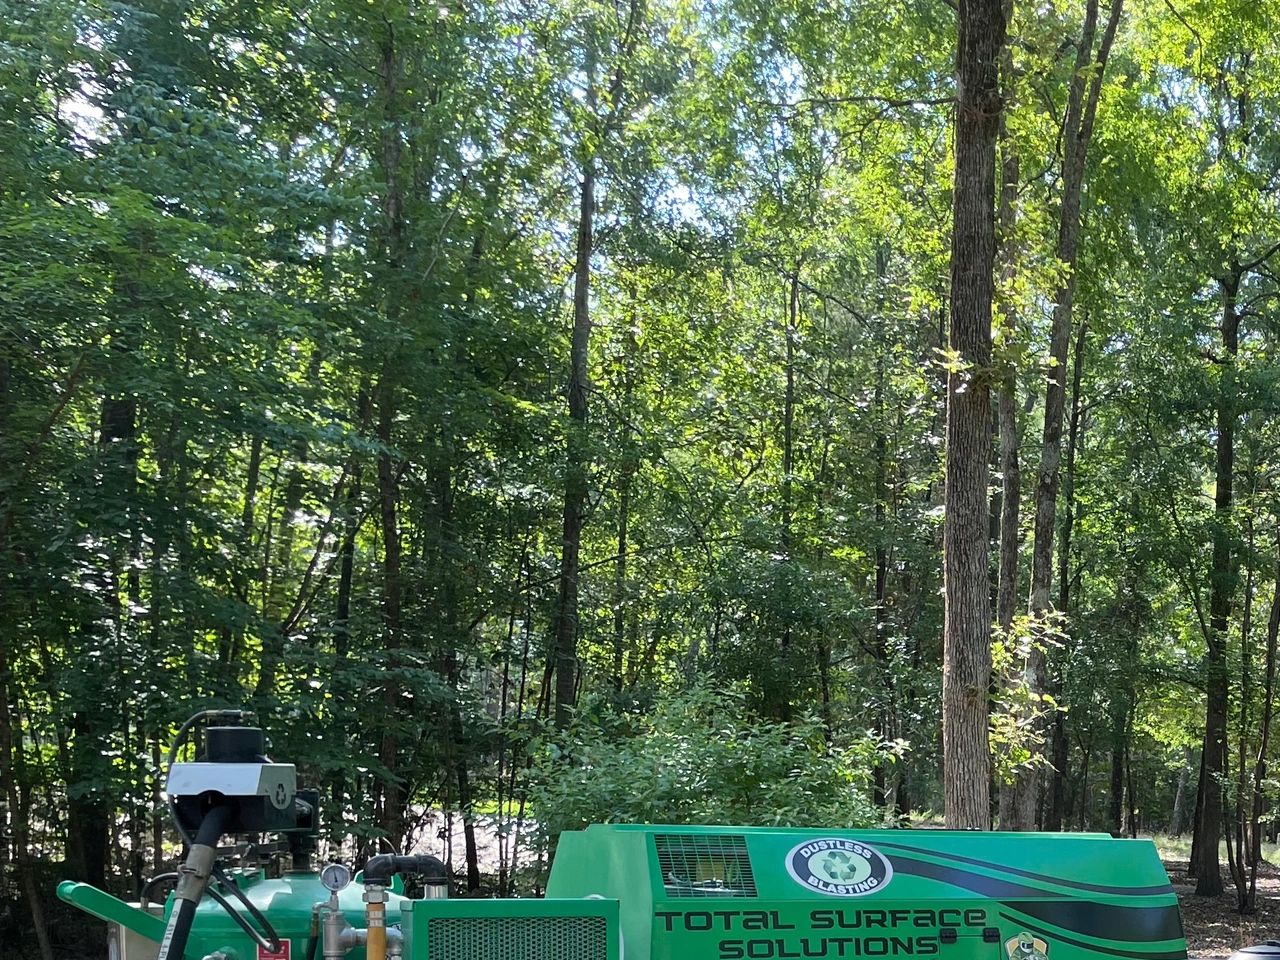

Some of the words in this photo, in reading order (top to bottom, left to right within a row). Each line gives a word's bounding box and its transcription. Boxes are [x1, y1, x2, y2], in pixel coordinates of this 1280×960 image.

[800, 840, 872, 858] DUSTLESS
[808, 875, 878, 894] BLASTING
[654, 910, 795, 932] TOTAL
[718, 936, 938, 959] SOLUTIONS
